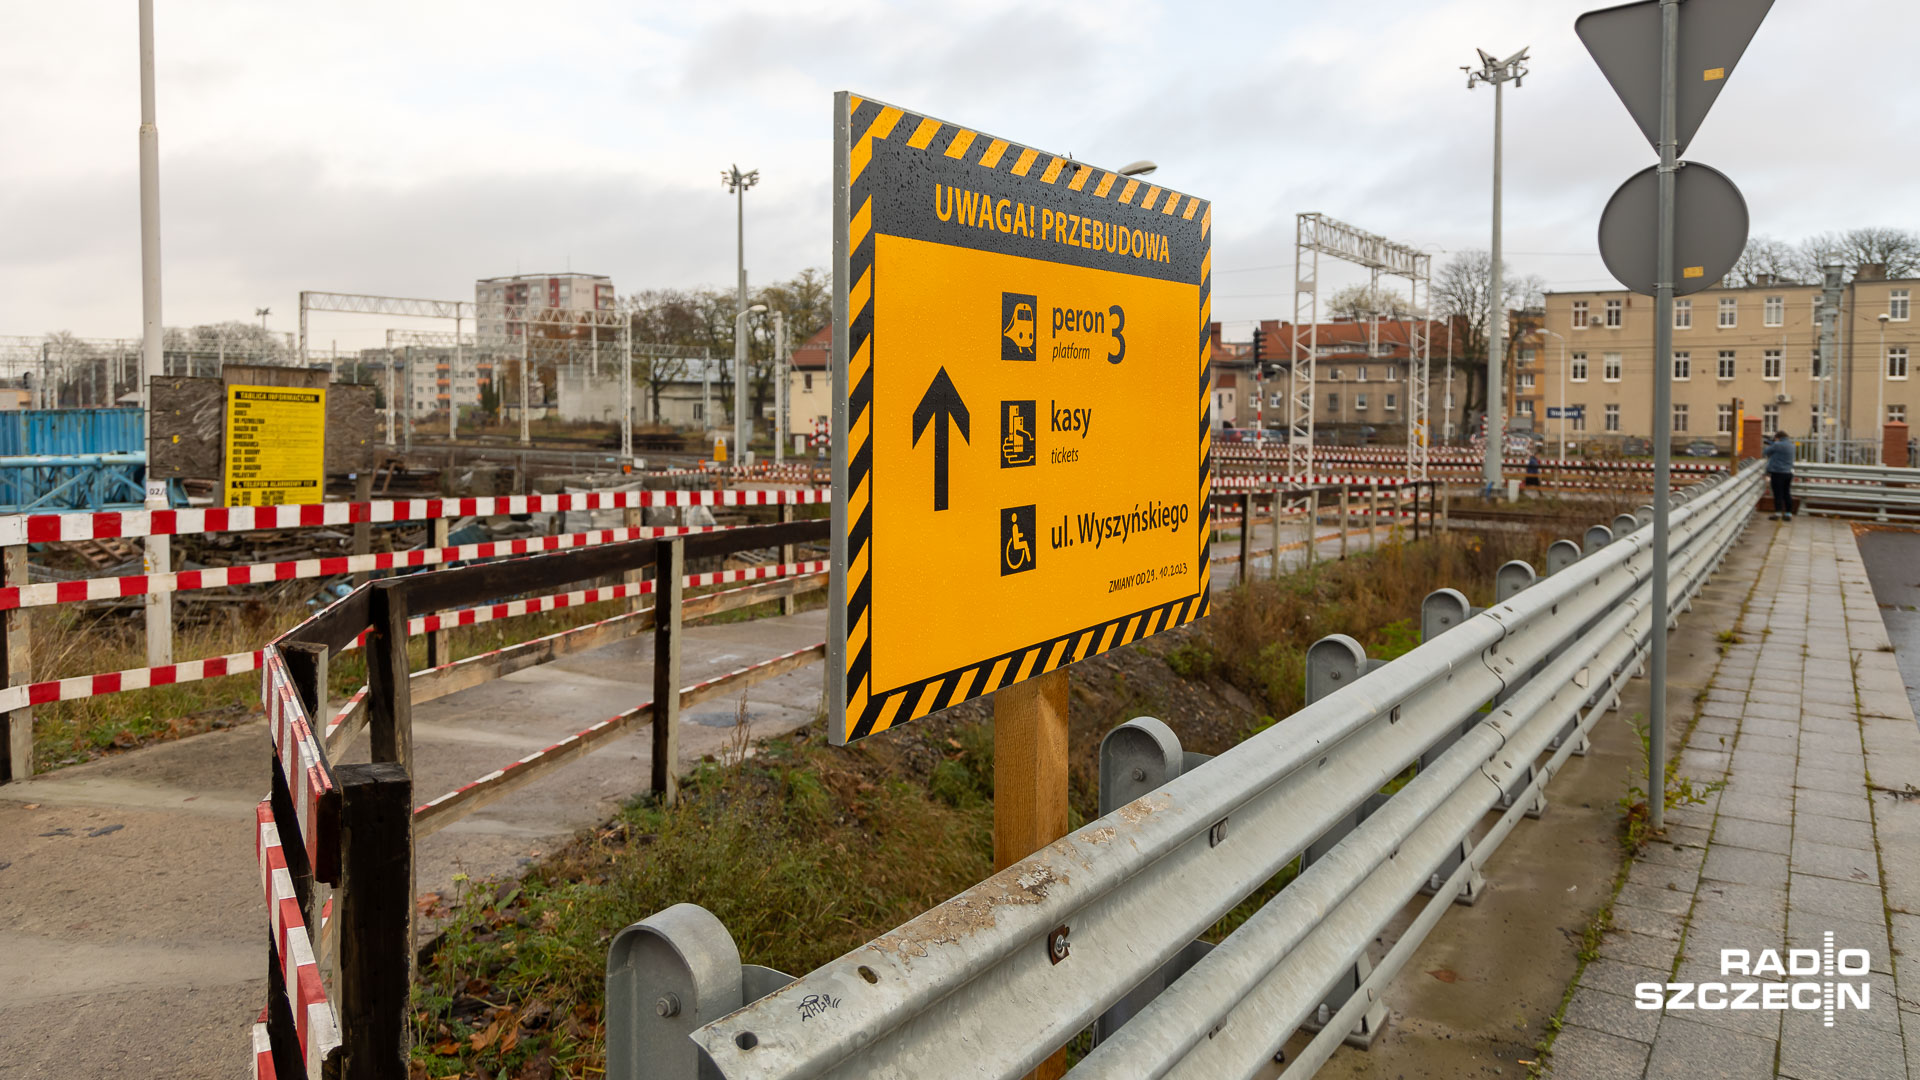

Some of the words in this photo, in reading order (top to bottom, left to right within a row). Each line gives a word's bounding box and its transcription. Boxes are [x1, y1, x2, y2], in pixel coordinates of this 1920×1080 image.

[935, 183, 1035, 239] UWAGA!
[1041, 208, 1170, 263] PRZEBUDOWA
[1052, 306, 1105, 339] peron
[1107, 304, 1126, 365] 3
[1052, 342, 1091, 362] platform
[1051, 399, 1092, 440] kasy
[1051, 446, 1079, 465] tickets
[1051, 515, 1074, 550] ul.
[1077, 500, 1189, 550] Wyszyńskiego
[1108, 574, 1135, 594] ZMIANY
[1135, 572, 1146, 586] OD
